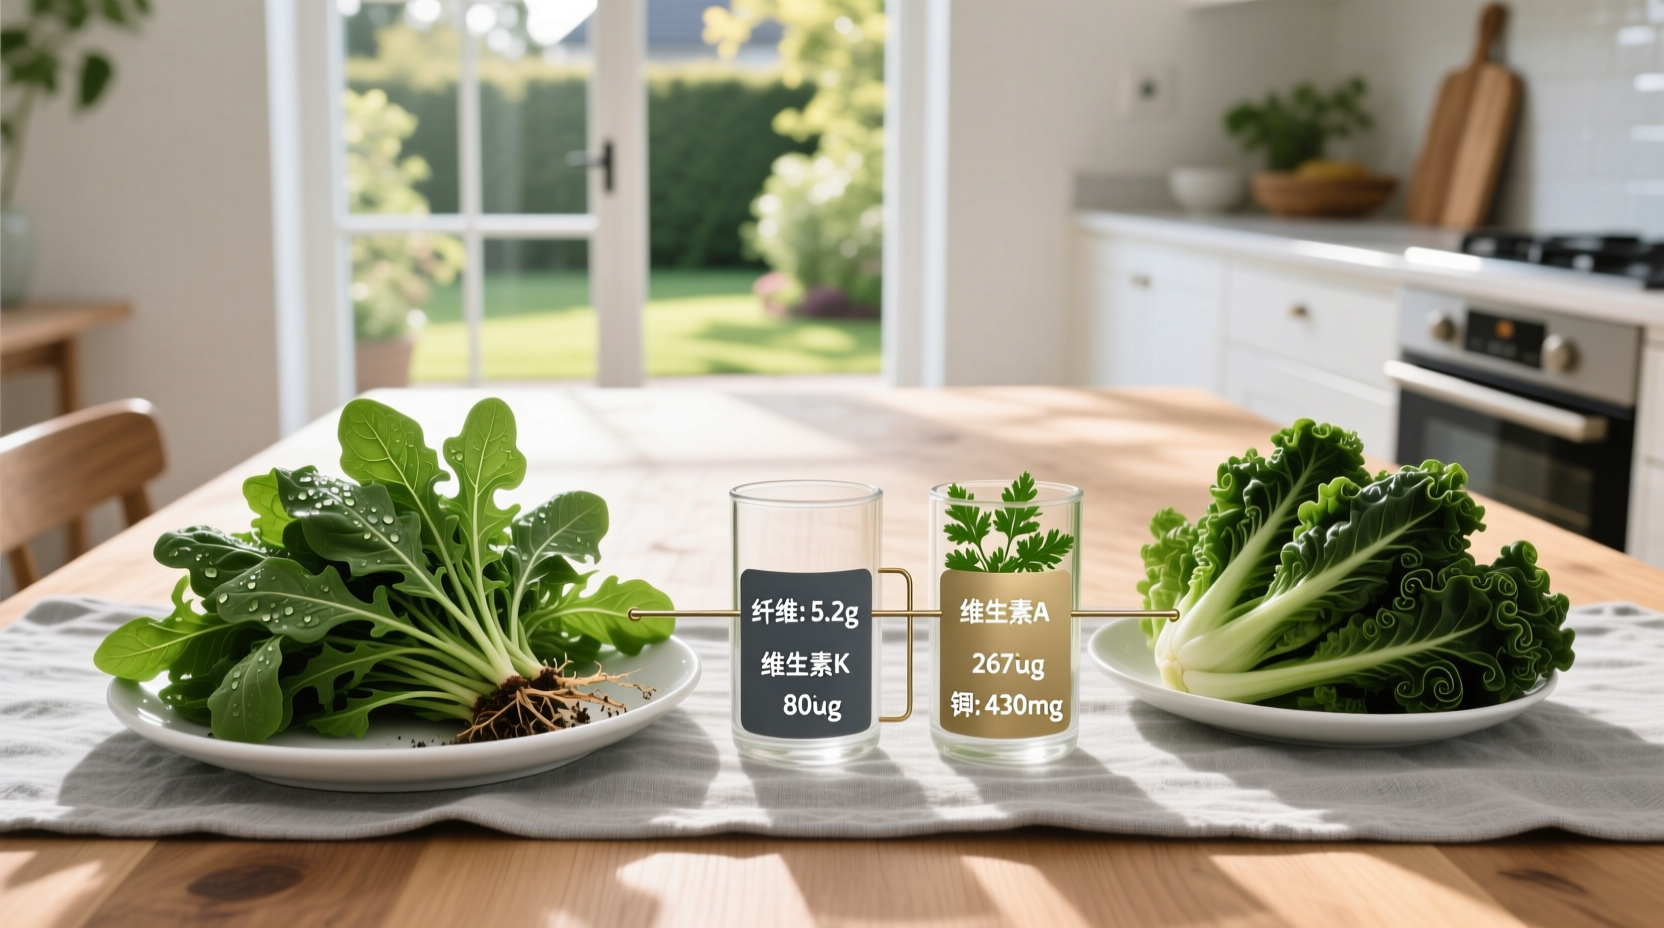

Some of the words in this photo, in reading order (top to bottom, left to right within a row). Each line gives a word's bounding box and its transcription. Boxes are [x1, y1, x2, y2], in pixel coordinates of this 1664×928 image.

[959, 598, 1050, 625] 维生素A
[760, 650, 851, 677] 维生素K
